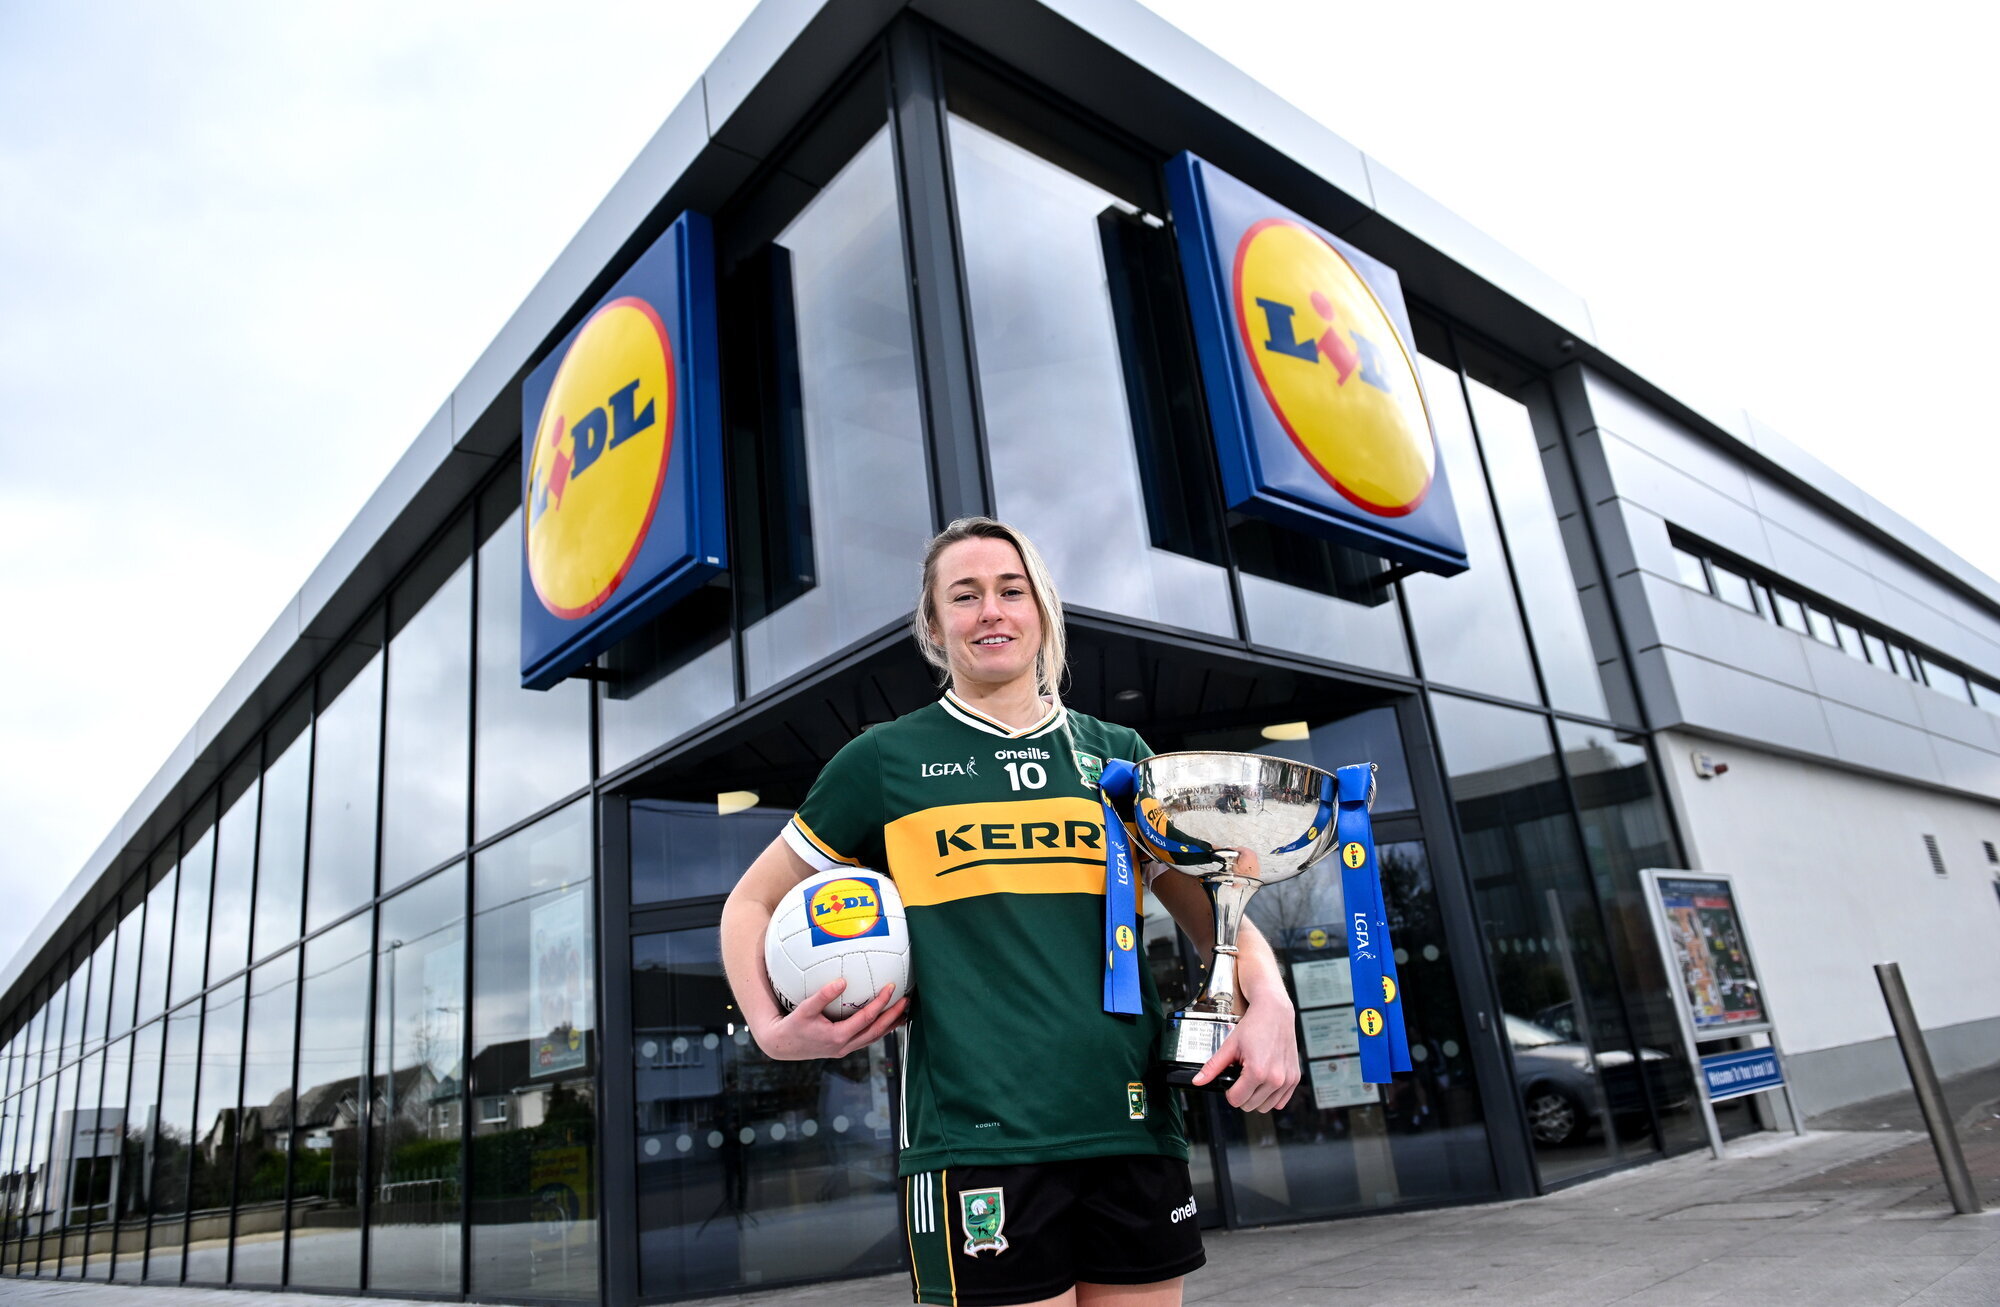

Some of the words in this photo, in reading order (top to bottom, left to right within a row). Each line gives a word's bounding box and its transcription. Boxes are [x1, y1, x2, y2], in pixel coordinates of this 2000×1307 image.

[921, 763, 966, 778] LGFA
[1003, 762, 1048, 791] 10
[935, 820, 1107, 858] KERR
[1117, 852, 1129, 886] LGFA
[1354, 912, 1370, 950] LGFA
